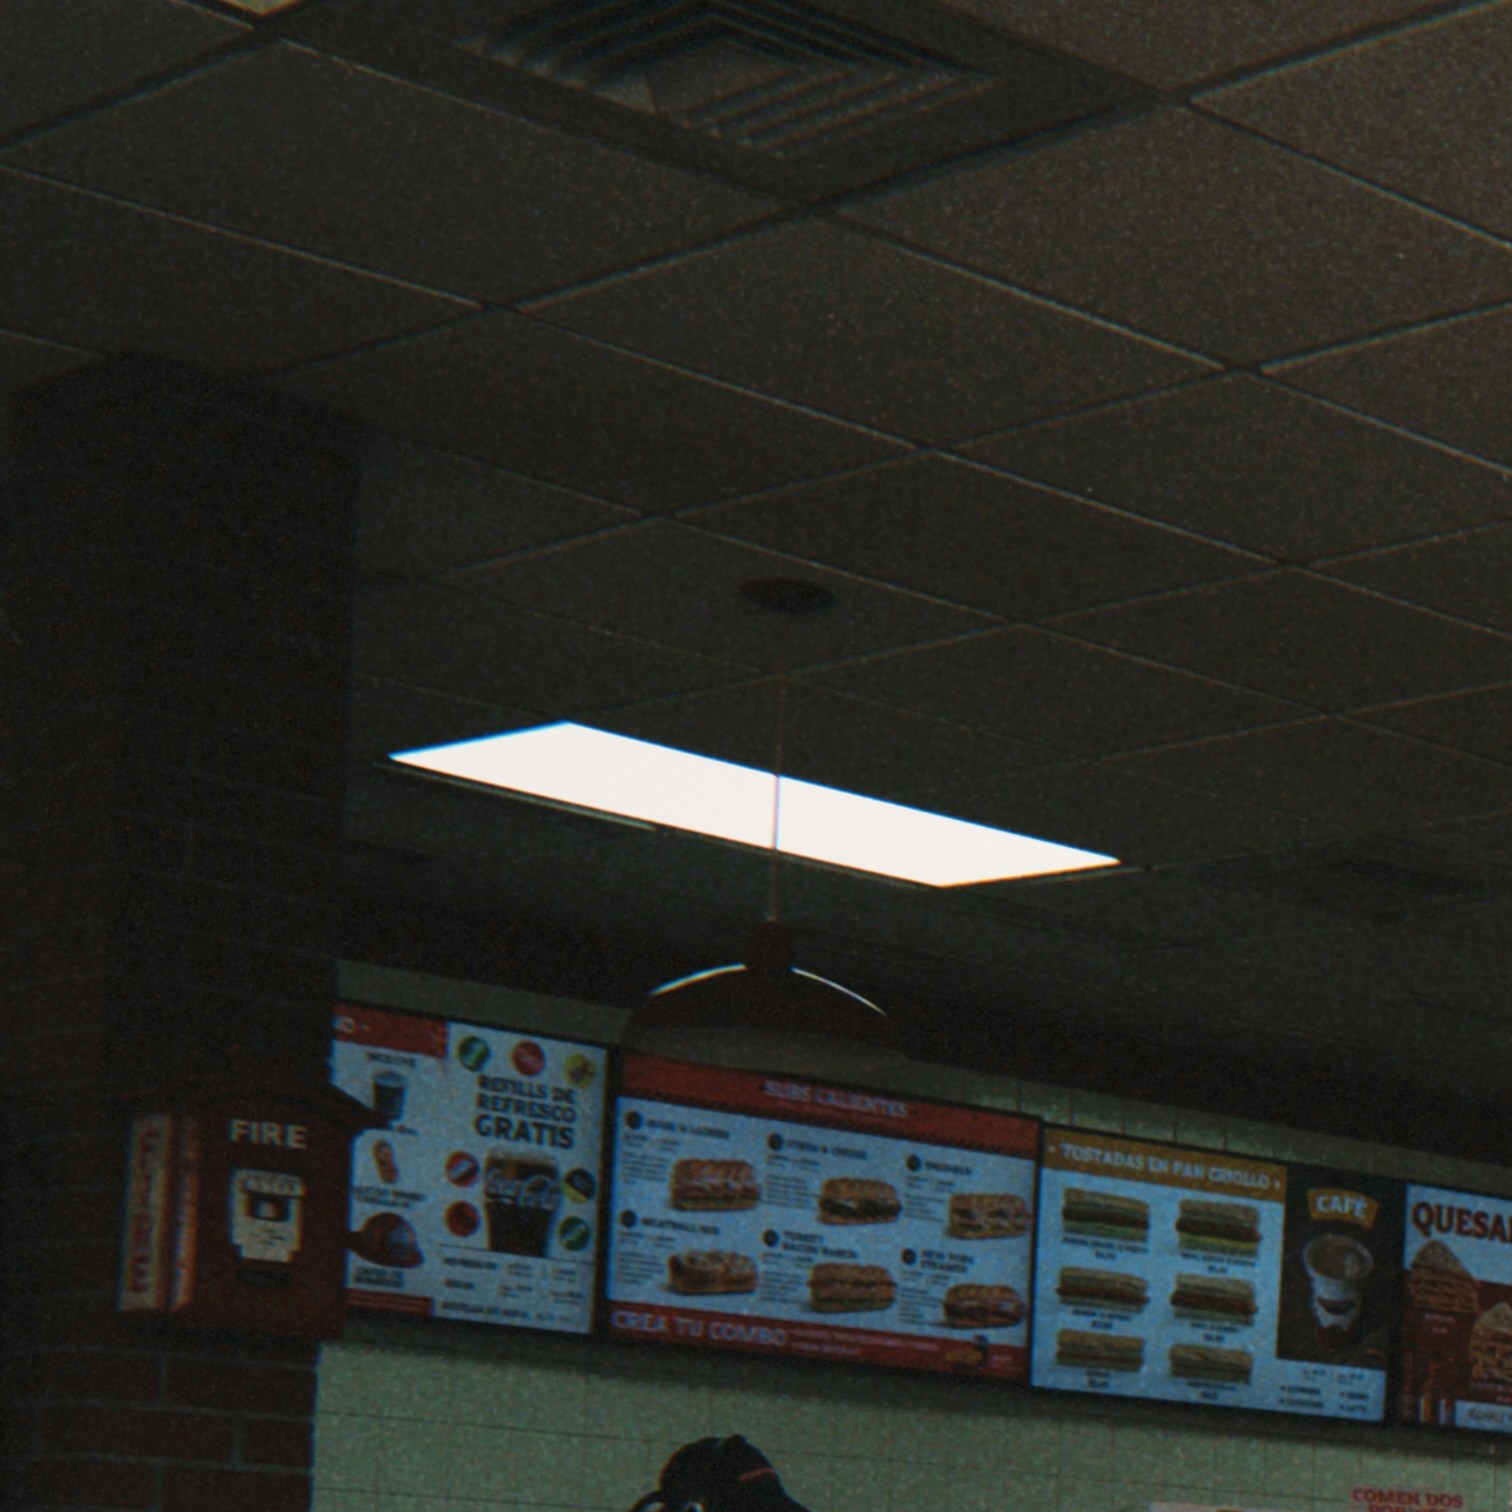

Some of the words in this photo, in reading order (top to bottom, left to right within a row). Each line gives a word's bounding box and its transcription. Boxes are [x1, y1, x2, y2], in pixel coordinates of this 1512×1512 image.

[478, 1075, 548, 1099] REFILLS
[552, 1087, 576, 1104] DE
[763, 1079, 810, 1101] SUBS
[814, 1086, 908, 1118] CALIENTES
[476, 1093, 577, 1123] REFRESCO
[228, 1119, 308, 1150] FIRE
[473, 1114, 577, 1150] GRATIS
[1059, 1142, 1143, 1172] TOSTADAS
[1172, 1160, 1205, 1181] PAN
[1208, 1166, 1271, 1191] CRIOLLO
[1315, 1191, 1369, 1219] CAFÉ
[610, 1310, 668, 1333] CREA
[674, 1317, 703, 1338] TU
[707, 1320, 788, 1347] COMBO
[1352, 1488, 1420, 1506] COMEN
[1427, 1493, 1463, 1509] DOS
